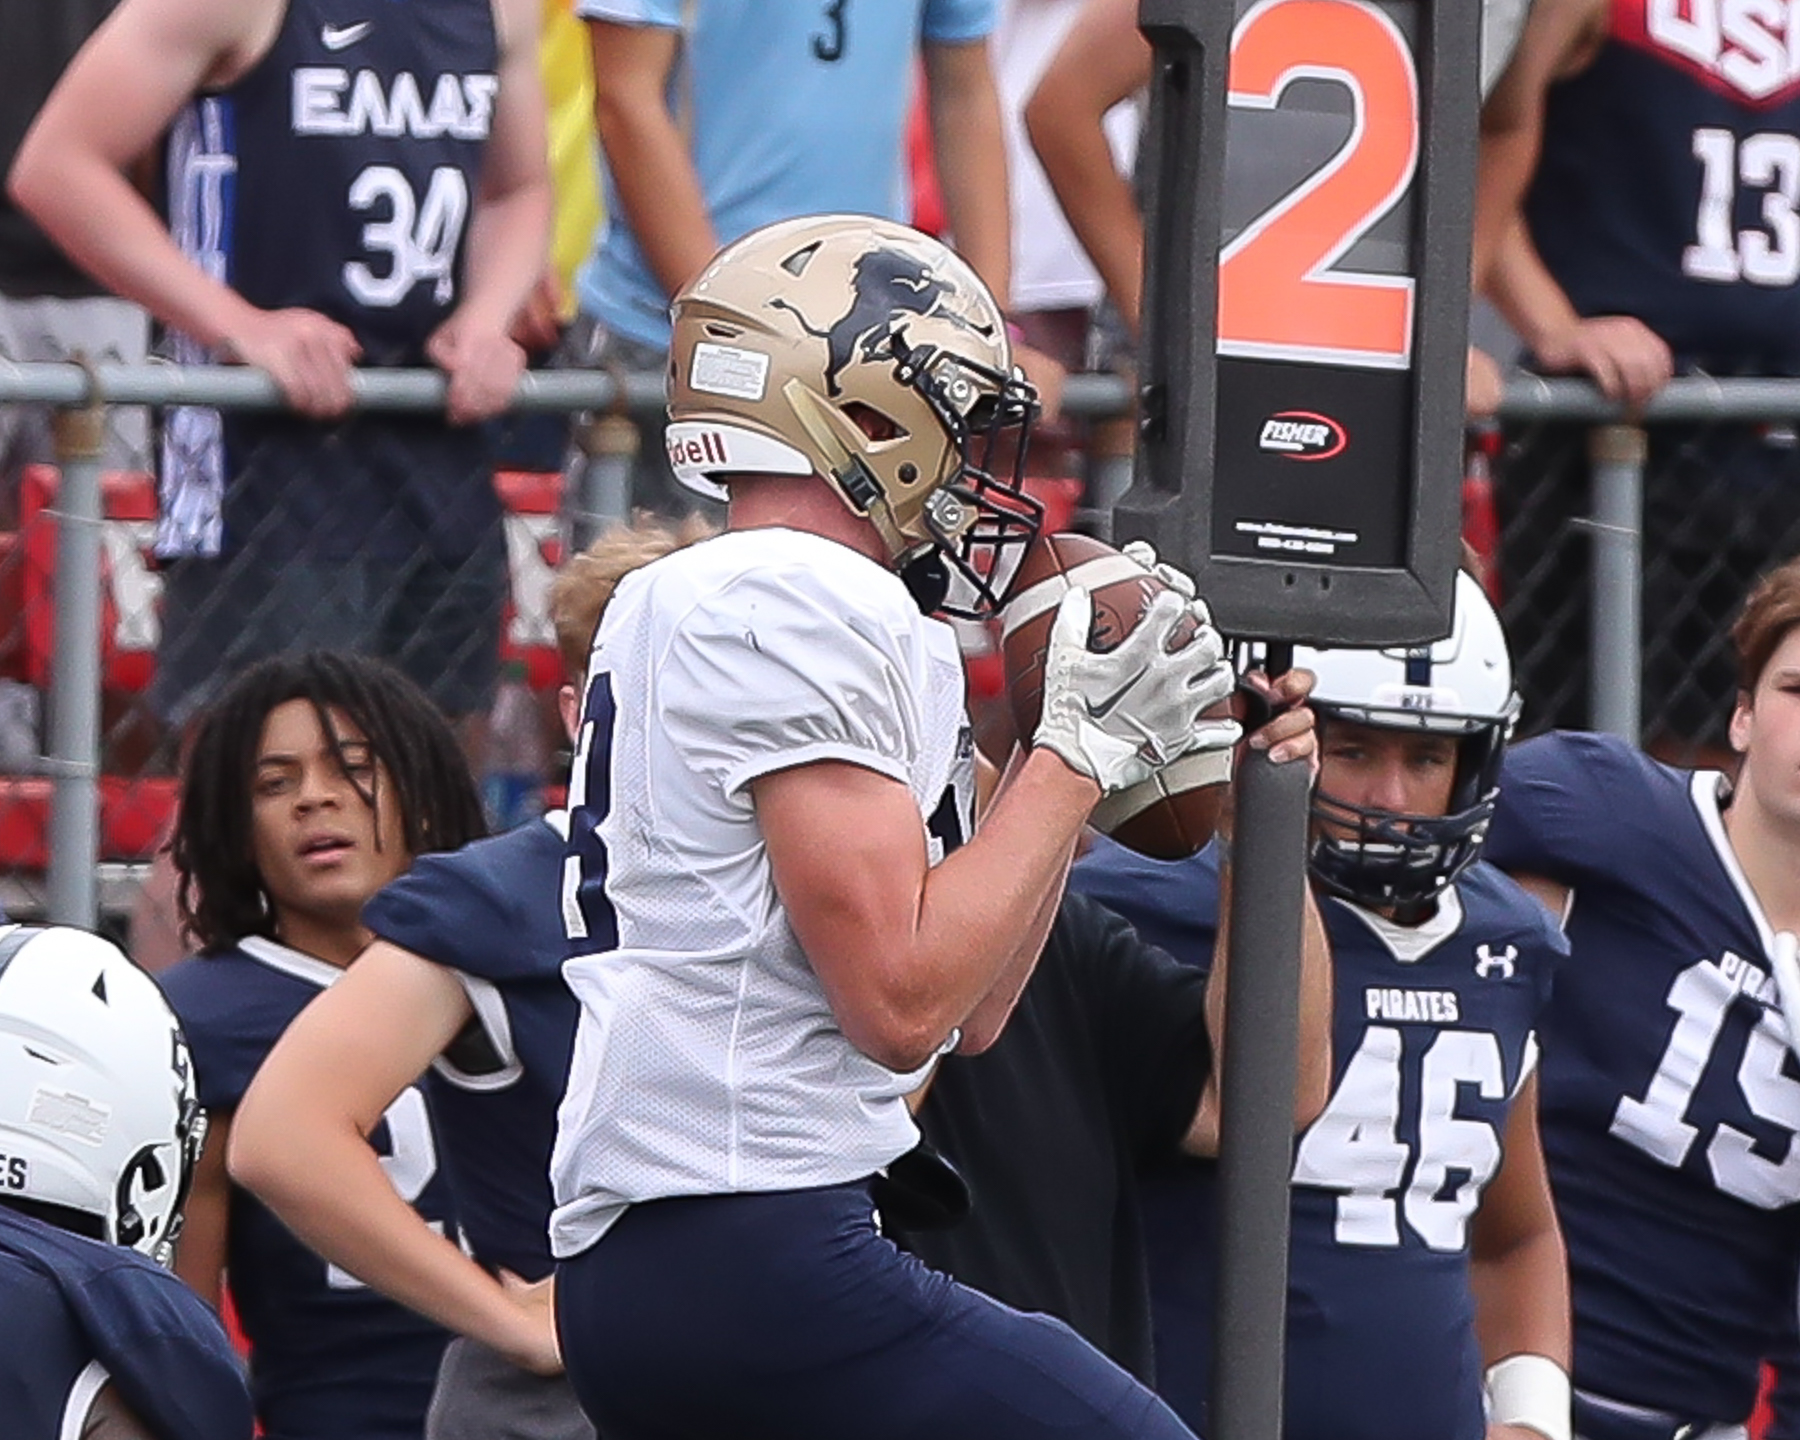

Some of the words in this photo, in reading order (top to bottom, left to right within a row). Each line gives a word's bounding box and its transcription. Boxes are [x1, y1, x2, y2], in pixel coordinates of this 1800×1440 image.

[343, 165, 468, 307] 34
[1216, 0, 1419, 369] 2
[667, 432, 727, 467] dell
[1366, 987, 1459, 1022] PIRATES
[1290, 1024, 1505, 1252] 46
